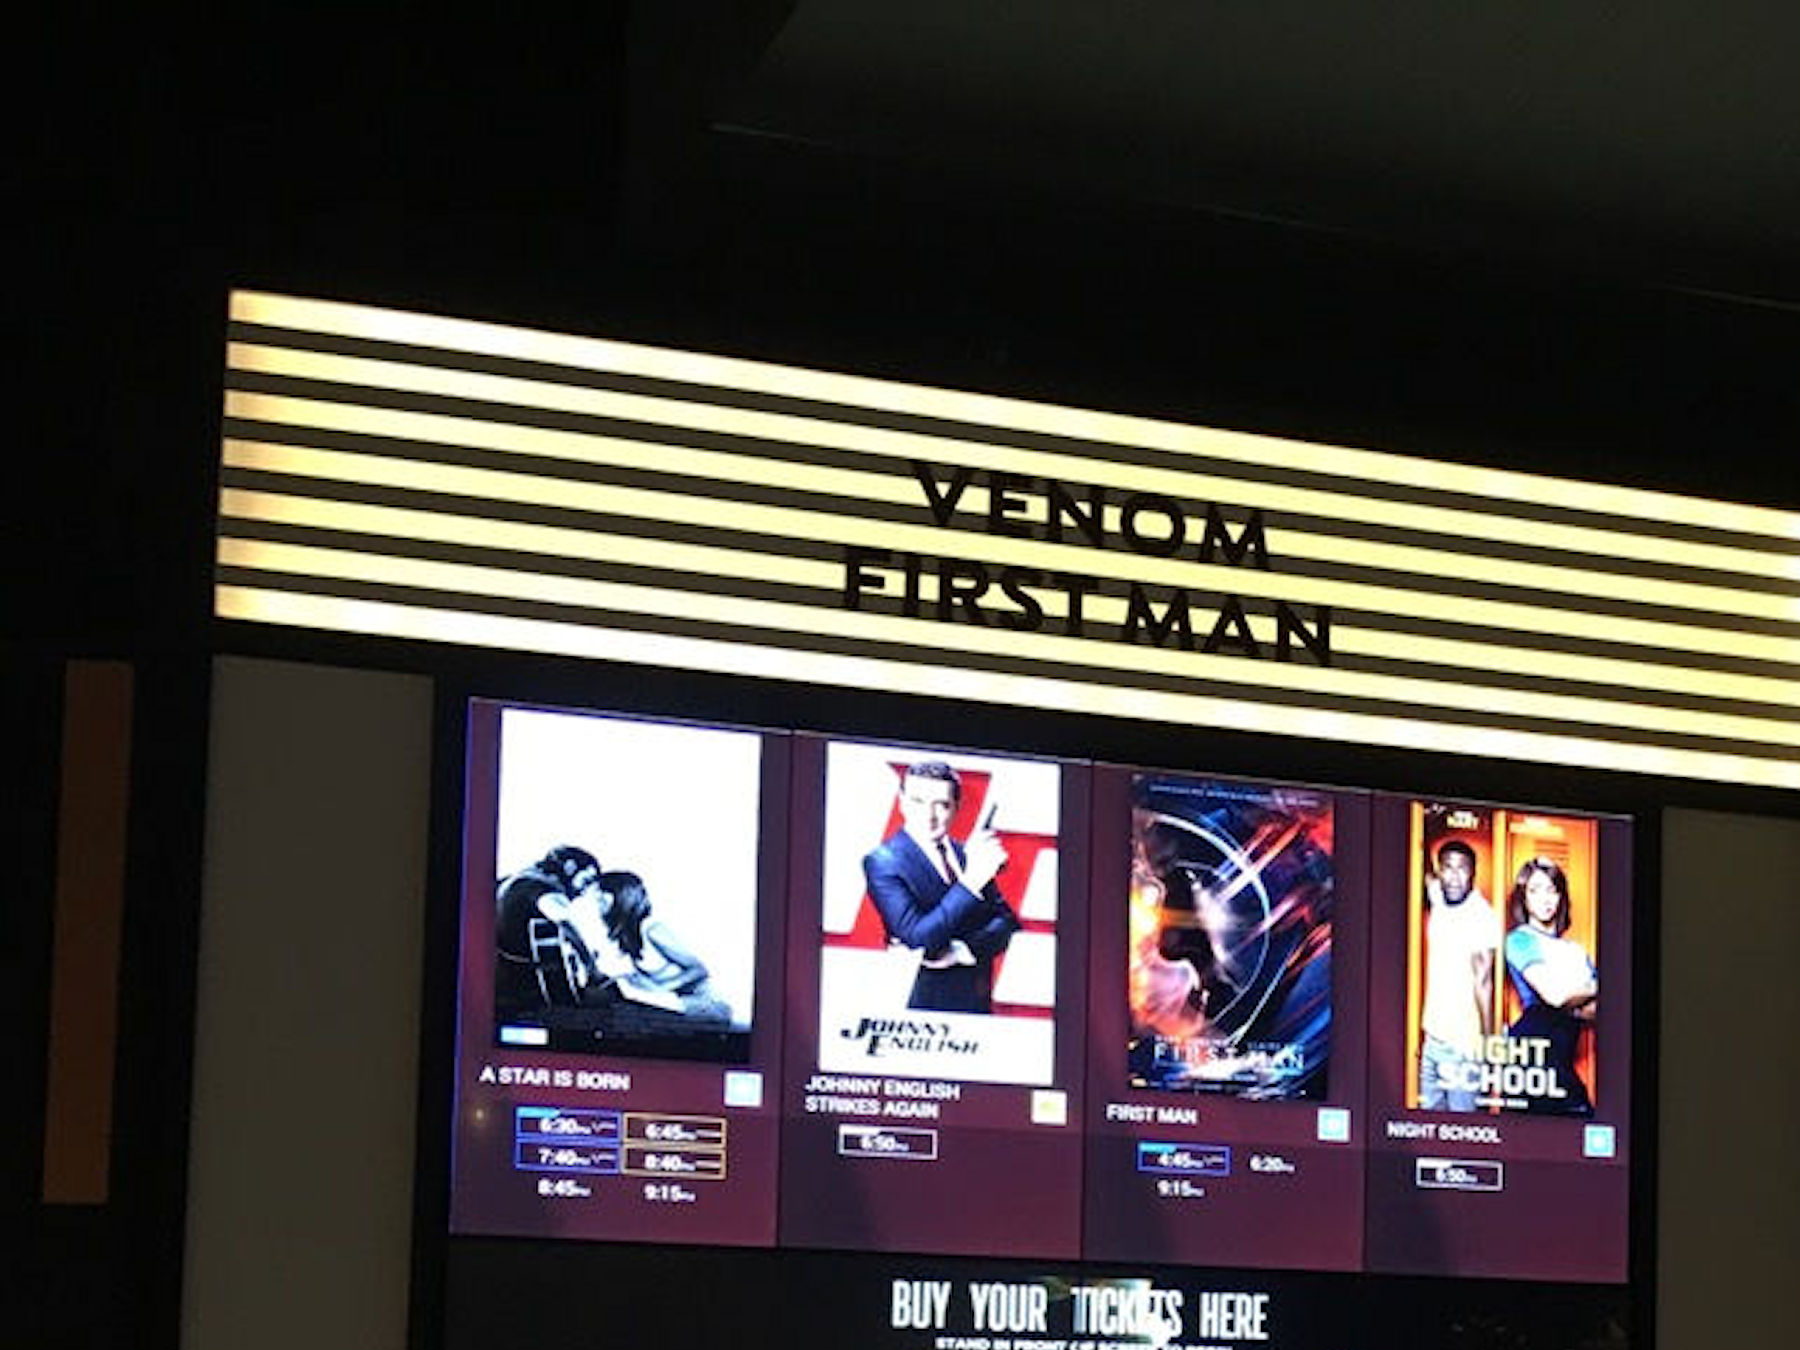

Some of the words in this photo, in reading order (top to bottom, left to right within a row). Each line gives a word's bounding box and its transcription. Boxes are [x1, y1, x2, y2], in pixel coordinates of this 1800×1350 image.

[912, 460, 1269, 571] VENOM
[844, 547, 1098, 637] FIRST
[1126, 584, 1331, 667] MAN
[841, 1018, 951, 1039] JOHNNY
[866, 1034, 979, 1056] ENGLISH
[479, 1067, 495, 1083] A
[499, 1067, 549, 1086] STAR
[554, 1070, 573, 1087] IS
[577, 1071, 631, 1090] BORN
[805, 1076, 881, 1097] JOHNNY
[884, 1080, 960, 1100] ENGLISH
[1437, 1062, 1567, 1098] SCHOOL
[805, 1096, 879, 1115] STRIKES
[884, 1101, 940, 1119] AGAIN
[1106, 1104, 1154, 1122] FIRST
[1157, 1107, 1198, 1125] MAN
[1387, 1121, 1436, 1139] NIGHT
[1439, 1125, 1502, 1143] SCHOOL
[891, 1279, 952, 1329] BUY
[969, 1281, 1049, 1334] YOUR
[1070, 1285, 1184, 1339] TICKETS
[1200, 1291, 1270, 1341] HERE
